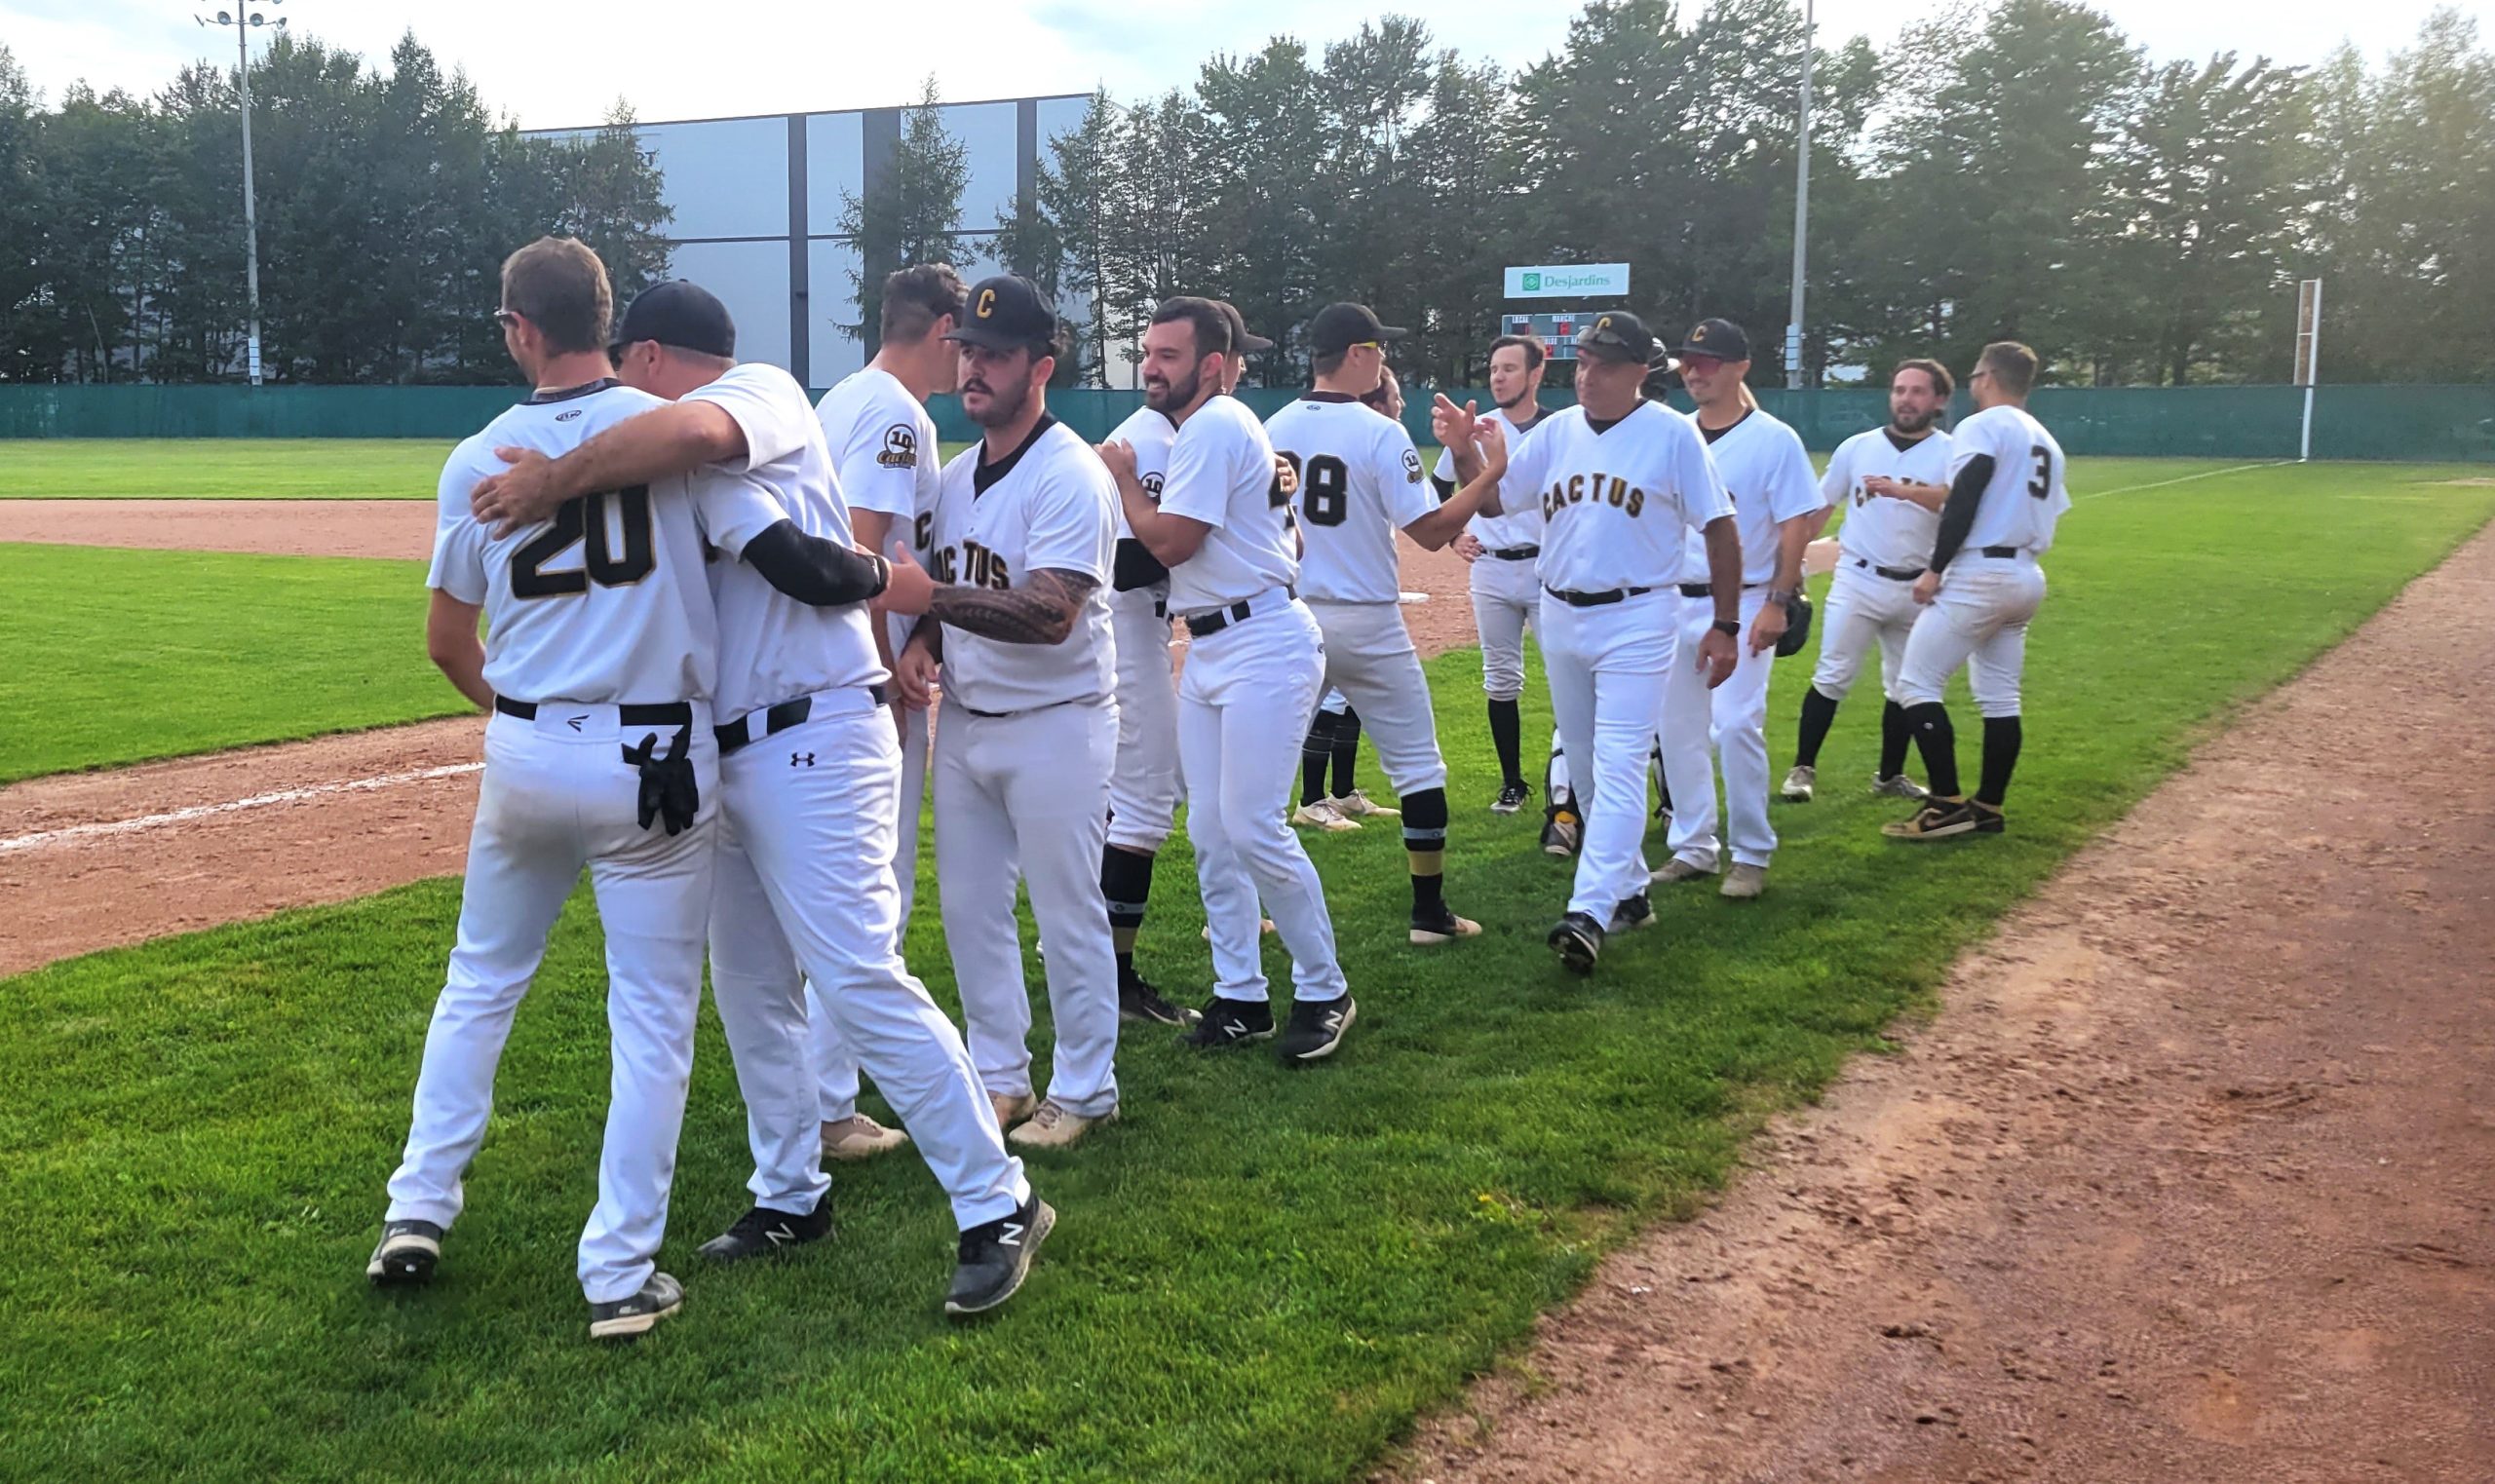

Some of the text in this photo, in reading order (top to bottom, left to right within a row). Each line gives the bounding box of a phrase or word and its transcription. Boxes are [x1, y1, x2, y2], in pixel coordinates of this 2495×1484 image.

[1545, 274, 1610, 289] Desjardins
[977, 288, 995, 319] C
[1693, 325, 1708, 341] C
[890, 431, 912, 448] 10
[2028, 444, 2052, 501] 3
[1544, 473, 1644, 524] CACTUS
[510, 485, 657, 600] 20
